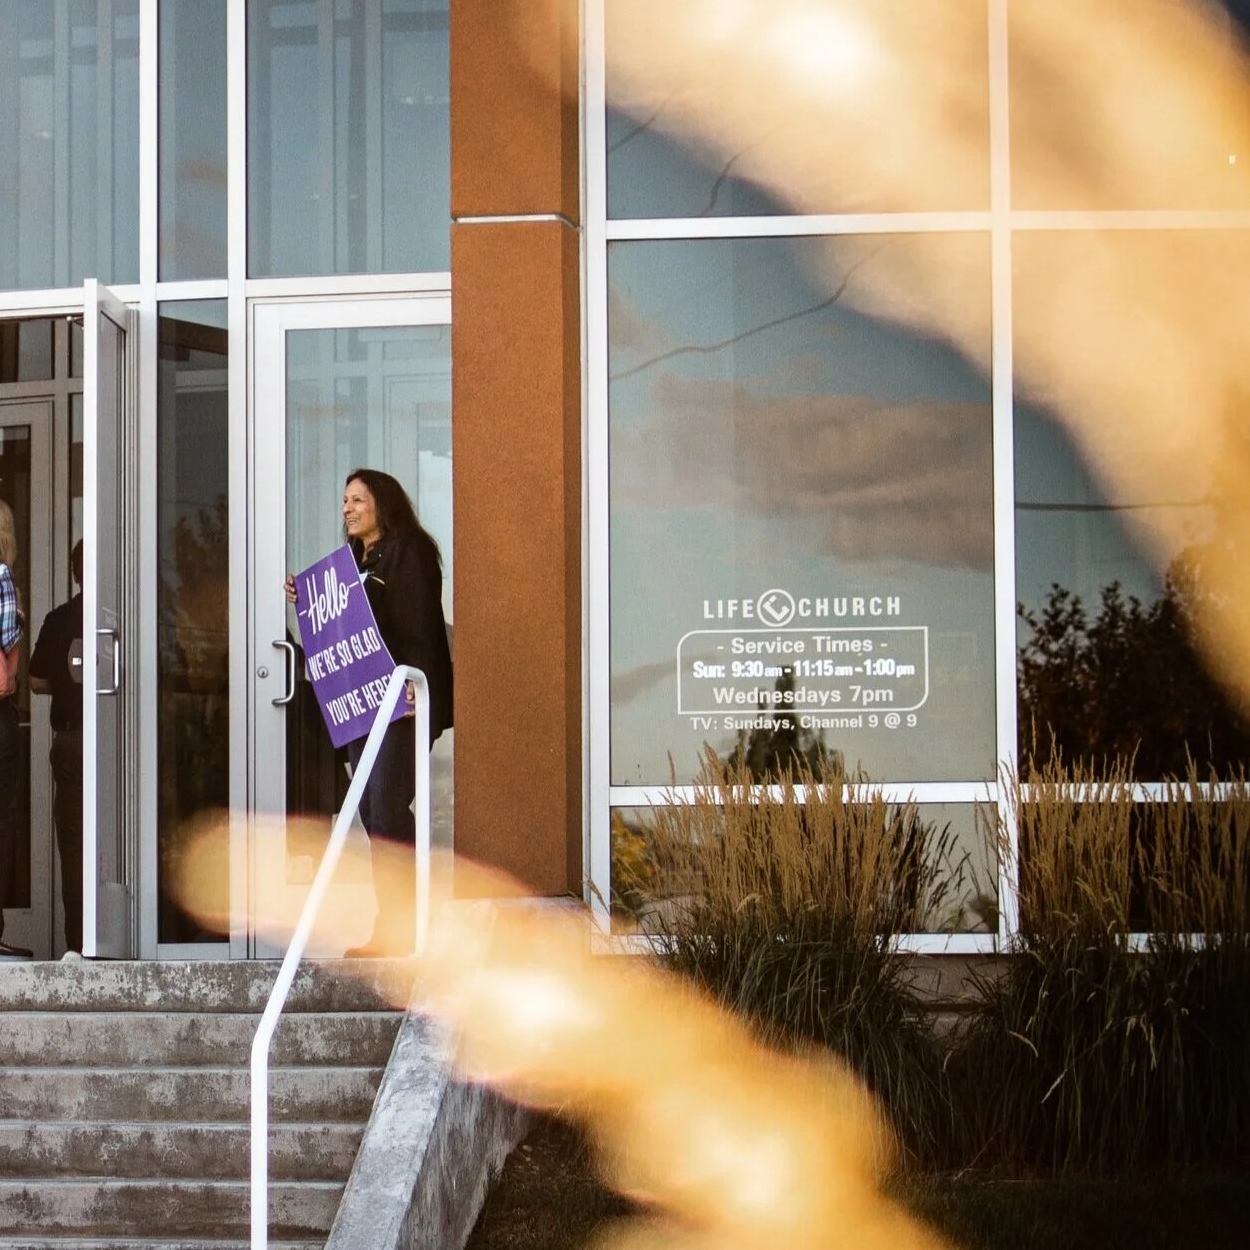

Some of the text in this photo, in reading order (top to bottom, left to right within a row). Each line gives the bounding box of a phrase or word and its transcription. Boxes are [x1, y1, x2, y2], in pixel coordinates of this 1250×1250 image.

[306, 566, 350, 635] Hello
[703, 596, 901, 619] LIFE CHURCH
[308, 626, 381, 682] WE'RE SO GLAD
[731, 637, 805, 654] Service
[812, 636, 873, 653] Times
[693, 660, 726, 678] Sun:
[713, 685, 894, 707] Wednesdays 7pm
[326, 688, 367, 727] YOU'RE
[690, 712, 918, 732] TV: Sundays, Channel 9 @ 9
